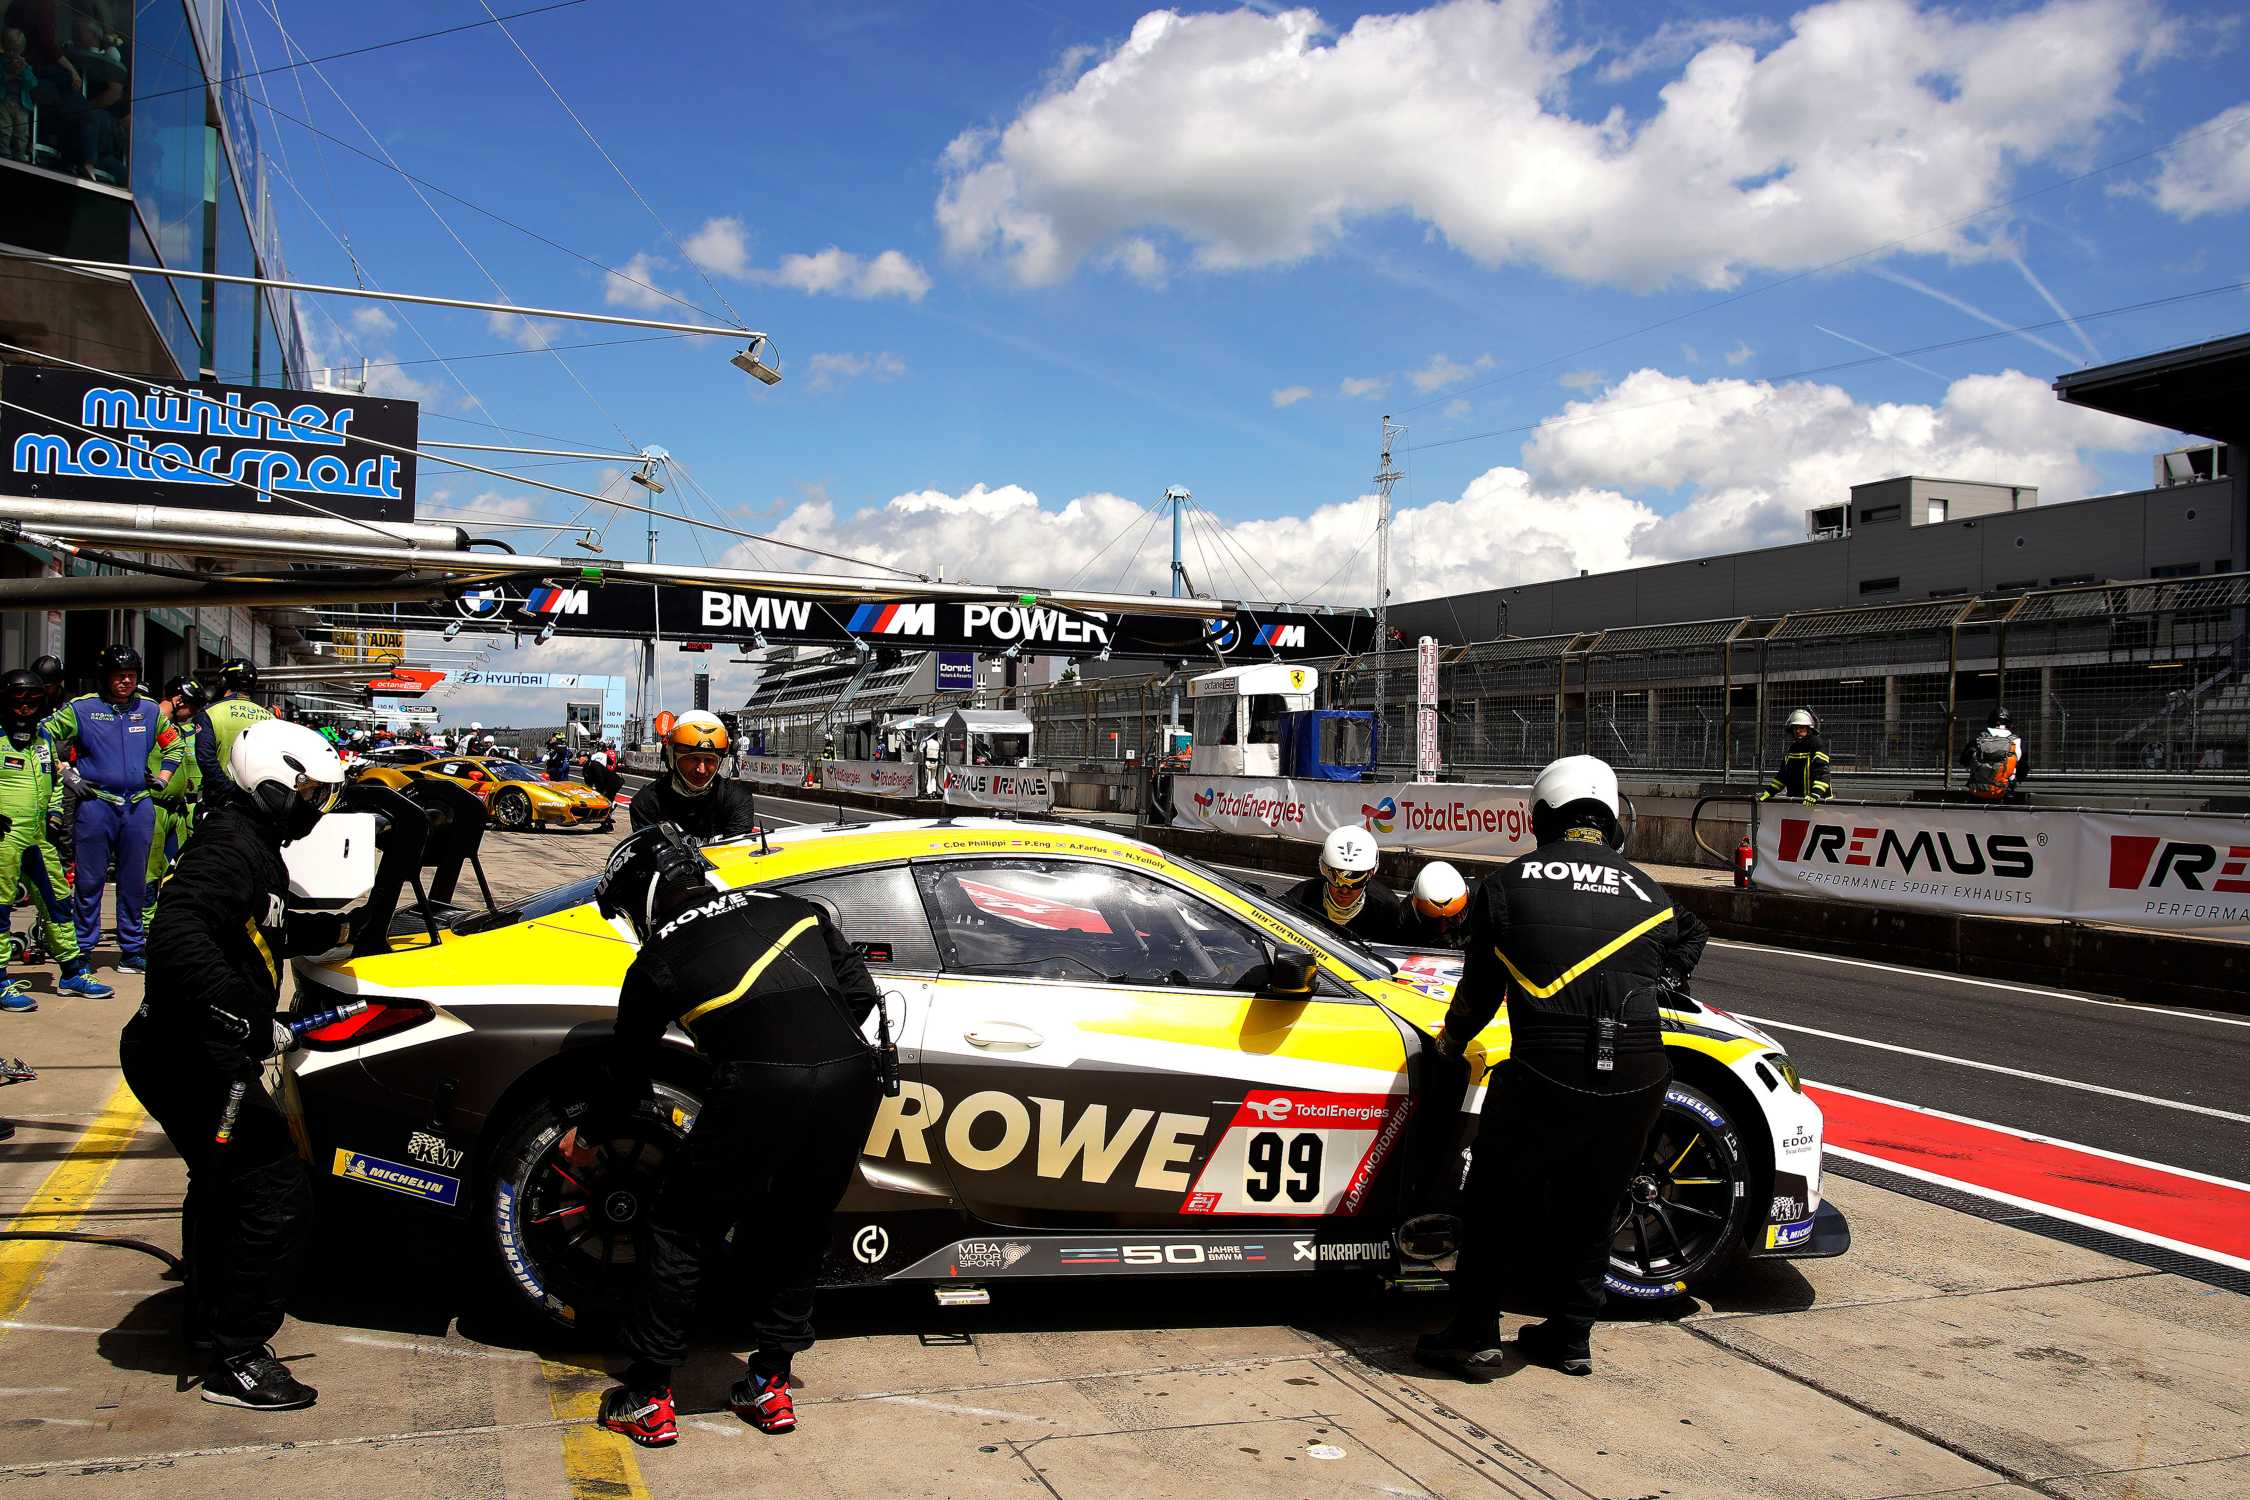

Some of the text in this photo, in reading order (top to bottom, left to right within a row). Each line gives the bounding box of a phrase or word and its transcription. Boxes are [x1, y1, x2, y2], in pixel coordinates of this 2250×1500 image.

[13, 432, 402, 502] motorsport
[702, 589, 812, 631] BMW
[883, 603, 936, 636] M
[963, 605, 1110, 644] POWER
[370, 632, 403, 648] ADAC
[486, 671, 543, 685] HYUNDAI
[940, 663, 972, 673] Dorint
[951, 773, 986, 793] REMUS
[999, 777, 1048, 797] REMUS
[1216, 791, 1305, 830] TotalEnergies
[967, 840, 1007, 850] Phillippi
[1024, 840, 1051, 849] P.Eng
[1069, 842, 1108, 855] A.Farfus
[1125, 852, 1166, 870] N.Yelloly
[1803, 824, 2033, 878] REMUS
[598, 845, 637, 897] uvex
[1521, 861, 1620, 887] ROWE
[1573, 880, 1620, 896] RACING
[1798, 871, 2032, 905] PERFORMANCE SPORT EXHAUSTS
[657, 891, 747, 940] ROWE
[706, 900, 749, 919] RACING
[1294, 1103, 1391, 1121] TotalEnergies
[863, 1079, 1210, 1193] ROWE
[1782, 1134, 1814, 1149] EDOX
[415, 1138, 464, 1170] KW
[1246, 1131, 1324, 1203] 99
[1345, 1096, 1415, 1213] ADAC NORDRHEIN
[369, 1167, 444, 1194] MICHELIN
[1775, 1202, 1804, 1222] KW
[498, 1191, 545, 1298] MICHELIN
[958, 1243, 1000, 1254] MBA
[958, 1253, 1002, 1261] MOTOR
[1122, 1244, 1205, 1265] 50
[1207, 1245, 1241, 1254] JAHRE
[1208, 1253, 1243, 1261] BMW M
[959, 1260, 1001, 1268] SPORT
